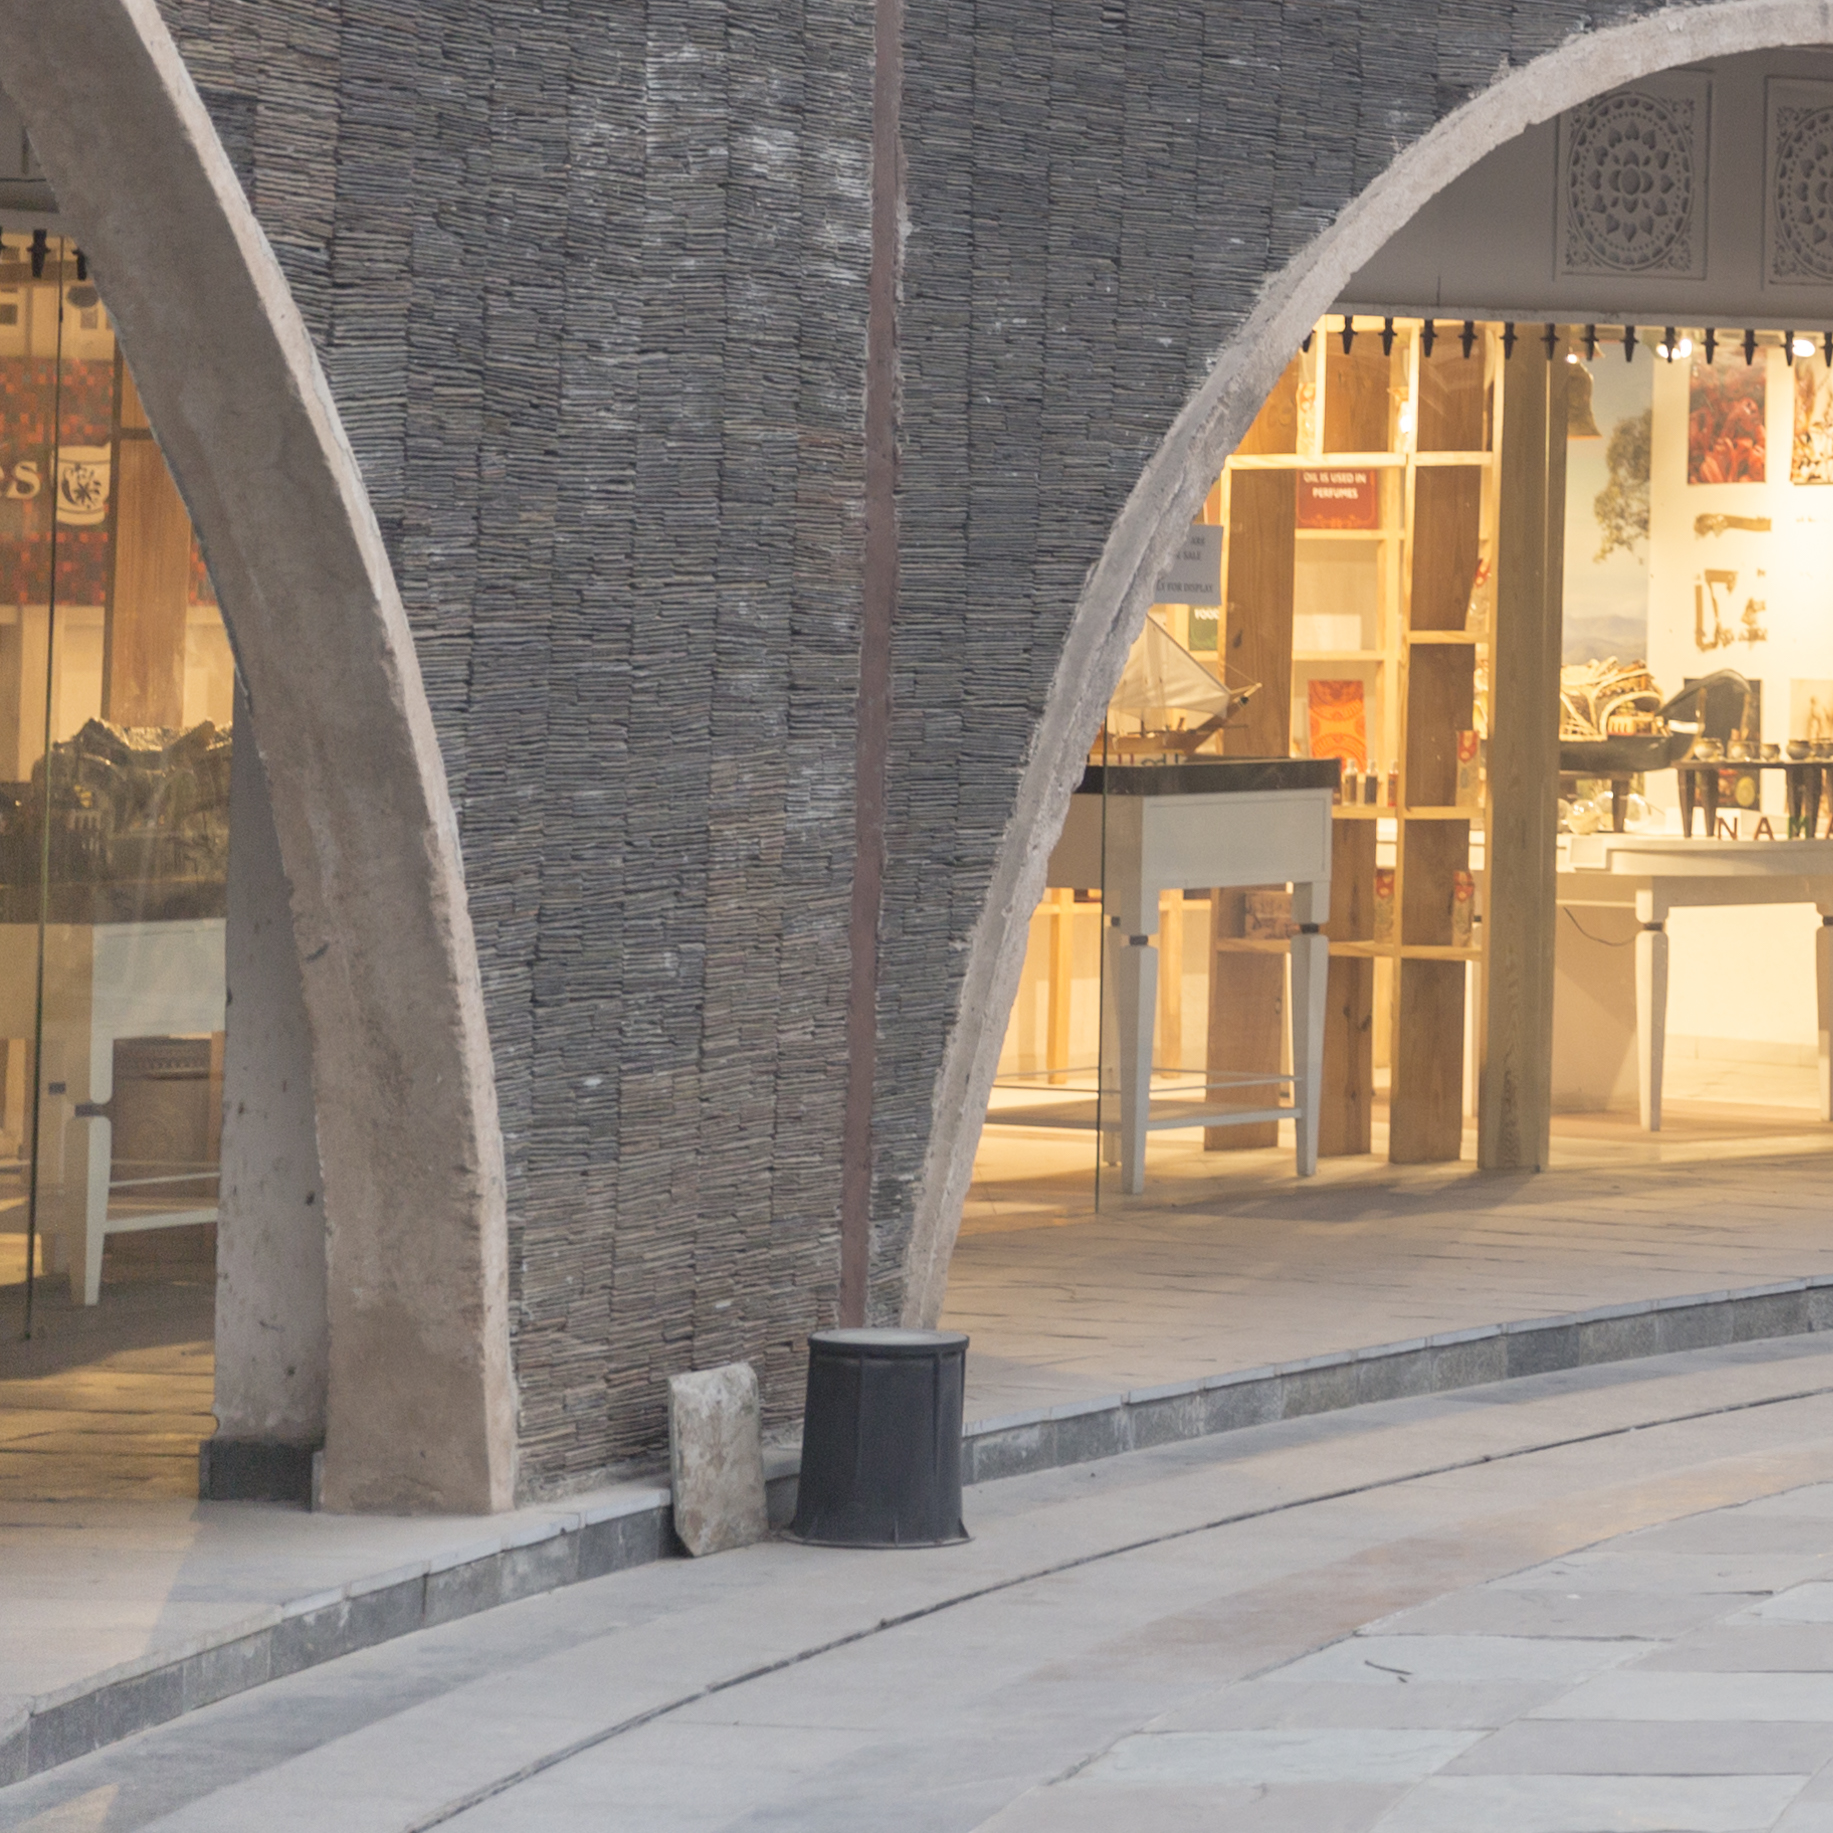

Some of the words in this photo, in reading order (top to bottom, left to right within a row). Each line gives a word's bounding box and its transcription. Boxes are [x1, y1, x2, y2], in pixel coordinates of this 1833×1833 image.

[1303, 471, 1319, 483] OIL
[1320, 471, 1330, 483] IS
[1330, 471, 1355, 484] USED
[1355, 472, 1367, 484] IN
[1312, 487, 1359, 500] PERFUMES
[1183, 550, 1201, 561] SALE
[1167, 582, 1182, 592] FOR
[1184, 582, 1214, 593] DISPLAY
